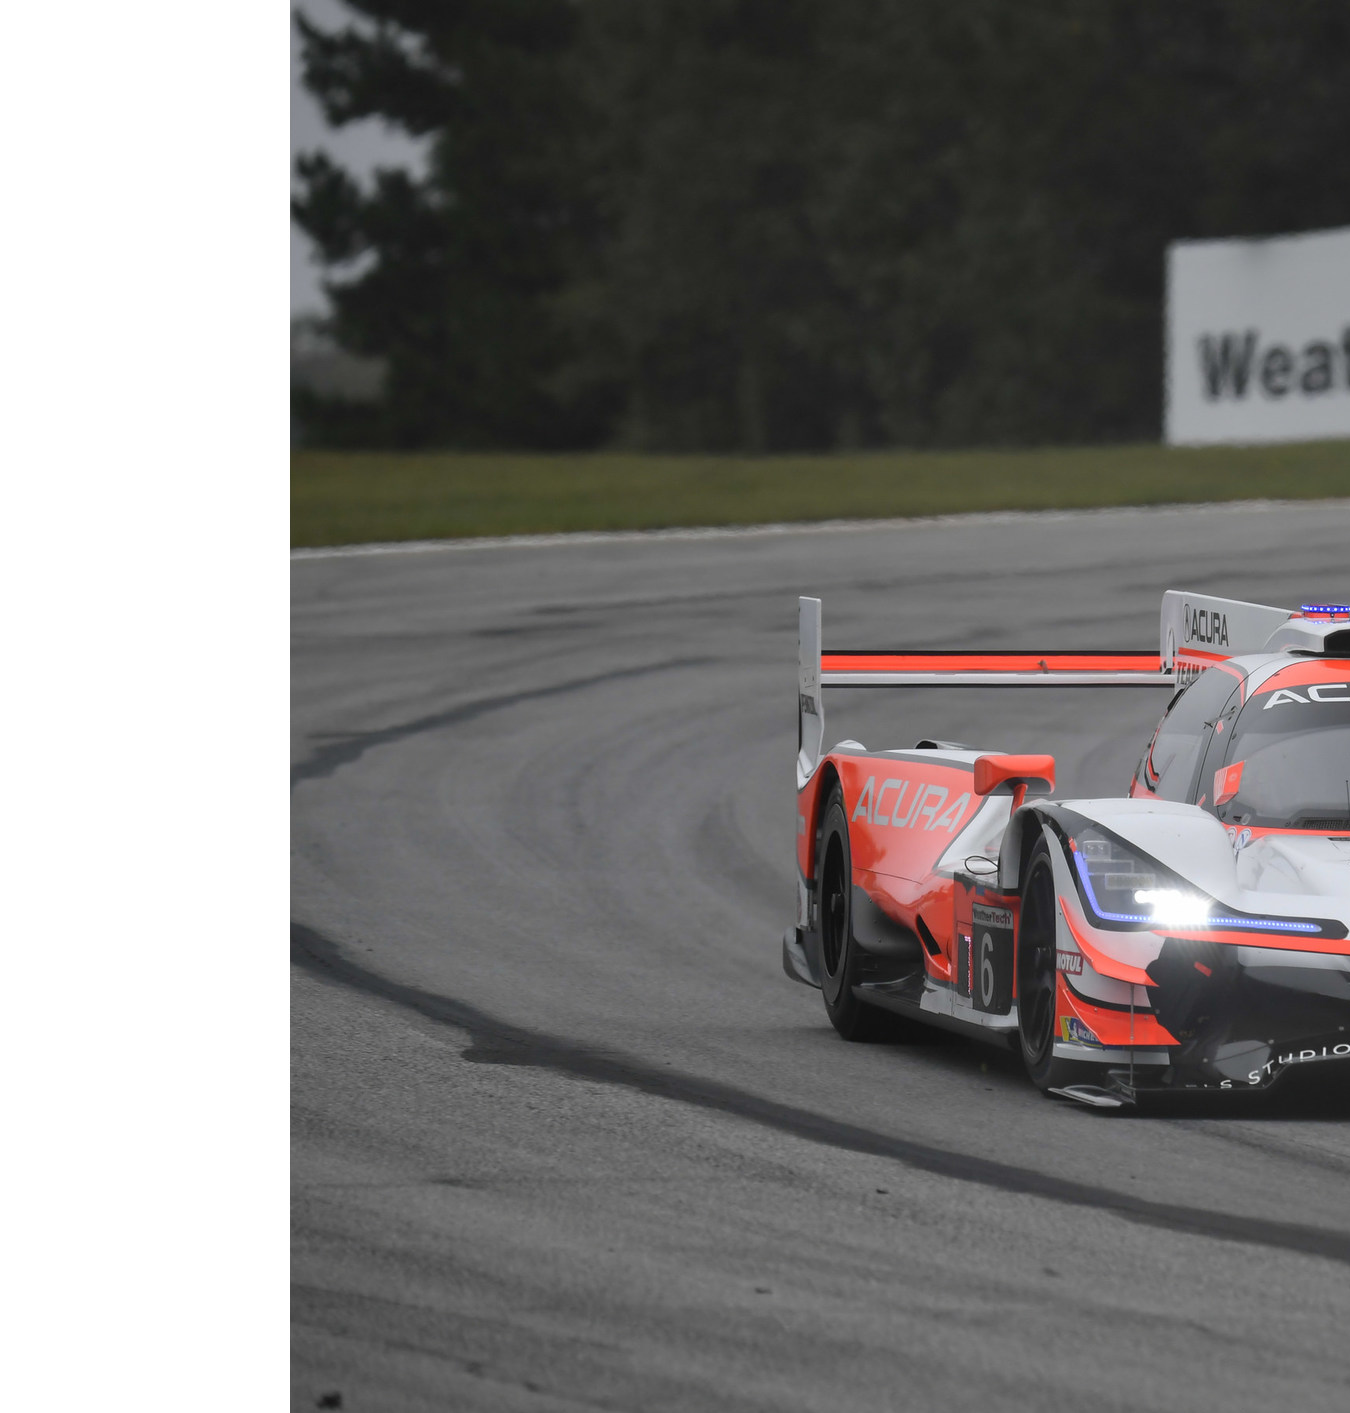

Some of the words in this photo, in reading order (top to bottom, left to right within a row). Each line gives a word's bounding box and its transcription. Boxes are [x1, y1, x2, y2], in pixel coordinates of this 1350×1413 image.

[1191, 608, 1229, 647] ACURA
[851, 775, 971, 833] ACURA
[981, 932, 993, 1007] 6
